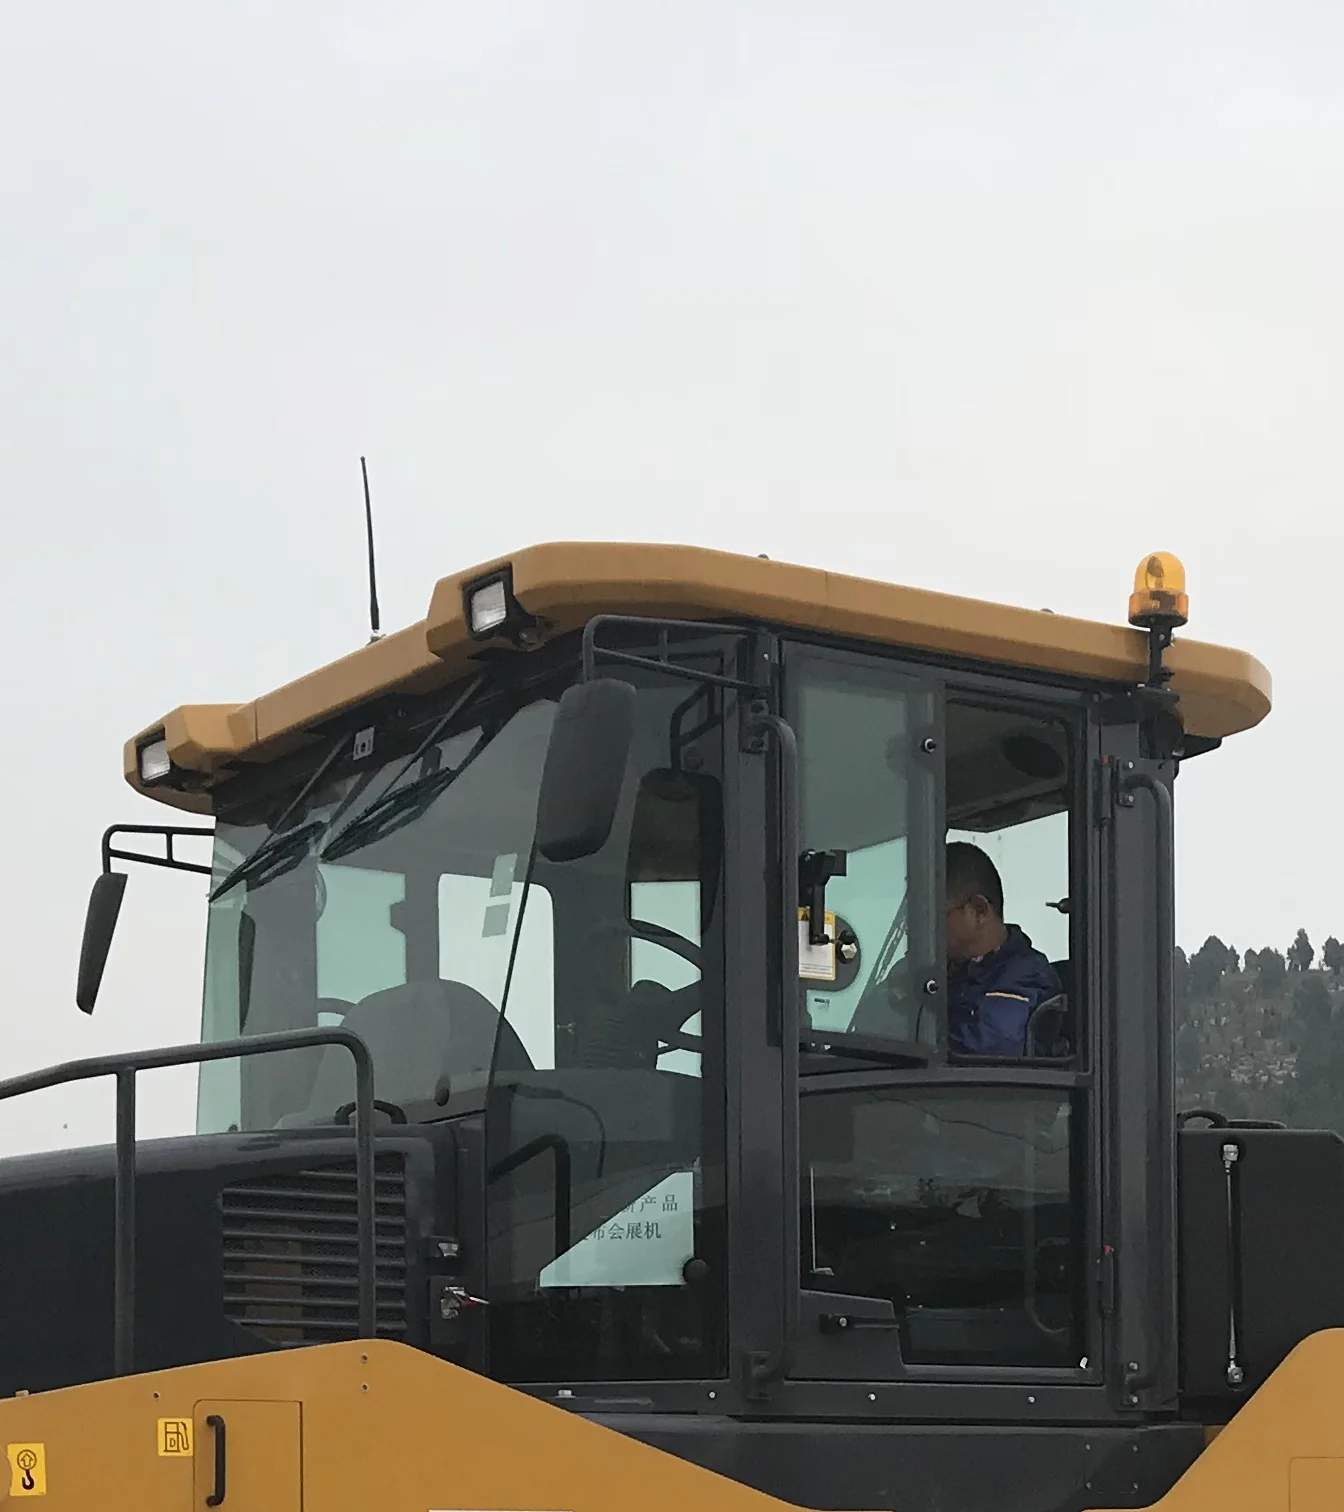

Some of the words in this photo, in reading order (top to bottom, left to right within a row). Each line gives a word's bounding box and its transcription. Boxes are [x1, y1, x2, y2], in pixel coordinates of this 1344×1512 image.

[583, 1221, 662, 1240] 布会展机
[169, 1437, 176, 1448] D
